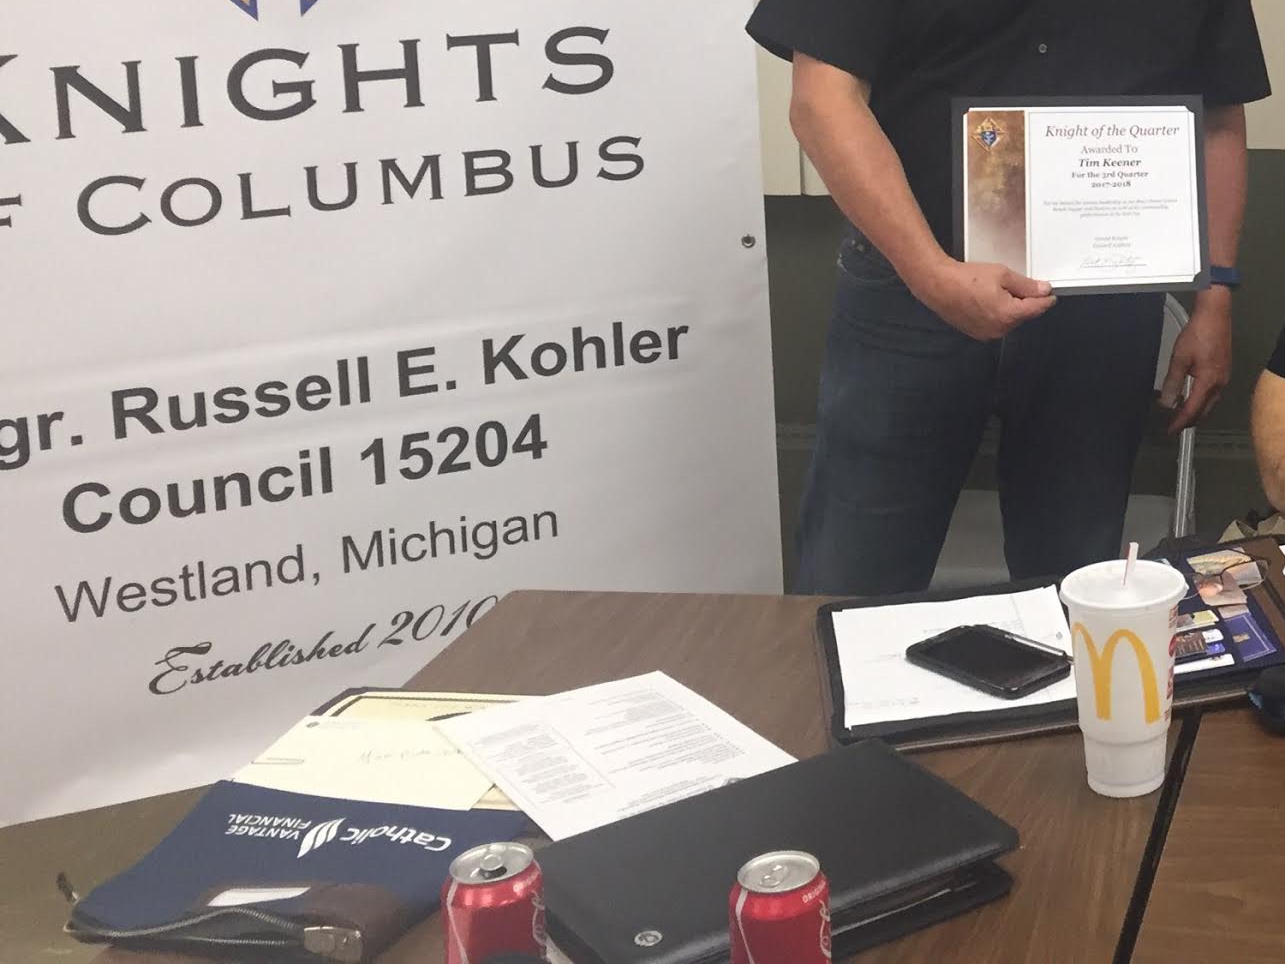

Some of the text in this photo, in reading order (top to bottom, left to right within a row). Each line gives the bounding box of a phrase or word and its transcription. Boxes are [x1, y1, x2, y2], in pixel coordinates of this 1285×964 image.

[1045, 123, 1180, 139] Knight of the Quarter
[1080, 144, 1138, 154] Awarded To
[1079, 157, 1142, 168] Tim Keener
[76, 135, 645, 236] COLUMBUS
[1071, 171, 1085, 179] For
[1087, 170, 1100, 179] the
[1117, 170, 1149, 179] Quarter
[110, 355, 371, 440] Russell
[396, 346, 457, 398] E.
[481, 321, 690, 385] Kohler
[62, 413, 548, 534] Council 15204
[54, 510, 559, 623] Westland, Michigan
[148, 622, 377, 696] Established
[225, 824, 300, 840] VANTAGE
[227, 813, 312, 830] FINANCIAL
[339, 824, 452, 852] Catholic
